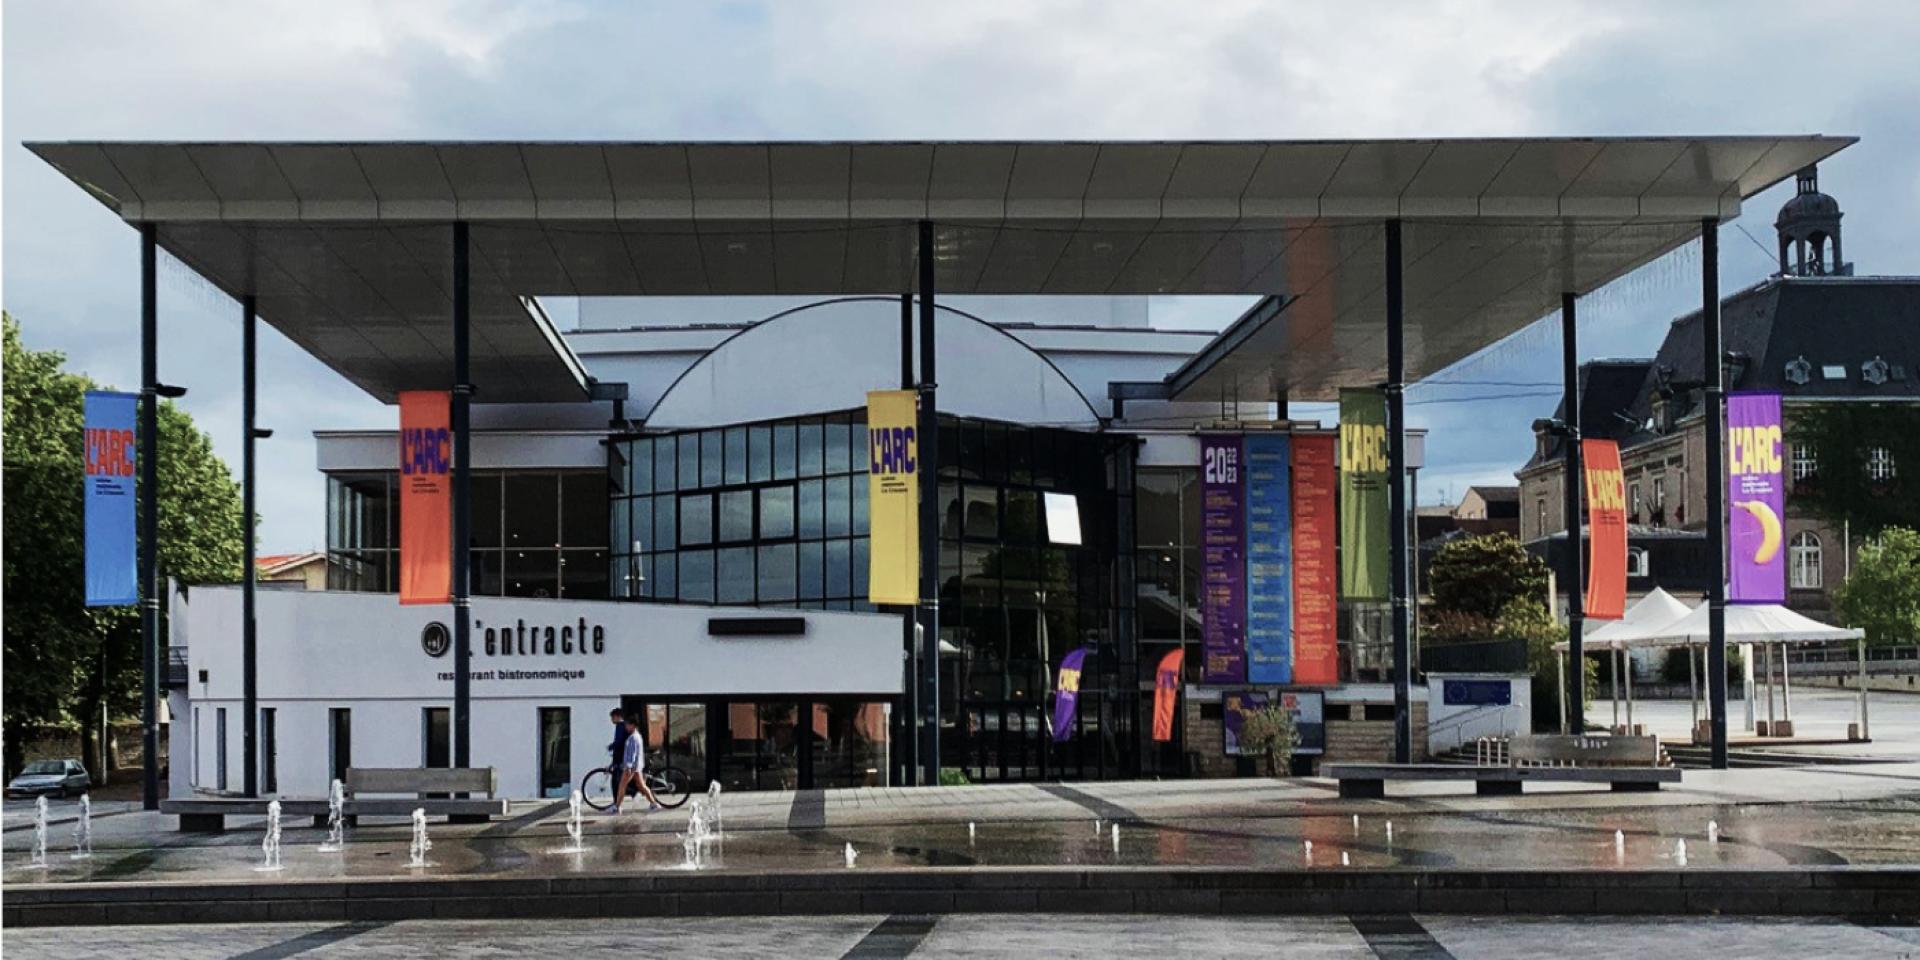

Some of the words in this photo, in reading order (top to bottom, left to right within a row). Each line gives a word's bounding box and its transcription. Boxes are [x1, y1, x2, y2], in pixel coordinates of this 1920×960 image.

[85, 428, 134, 477] L'ARC
[402, 427, 449, 475] L'ARC
[870, 426, 915, 474] L'ARC
[1205, 446, 1227, 484] 20
[1226, 446, 1238, 464] 22
[1340, 424, 1386, 472] L'ARC
[1728, 424, 1782, 474] L'ARC
[1226, 466, 1238, 484] 23
[1587, 469, 1625, 510] L'ARC
[467, 616, 605, 657] 'entracte
[438, 672, 495, 681] resrant
[498, 669, 585, 681] bistronomique
